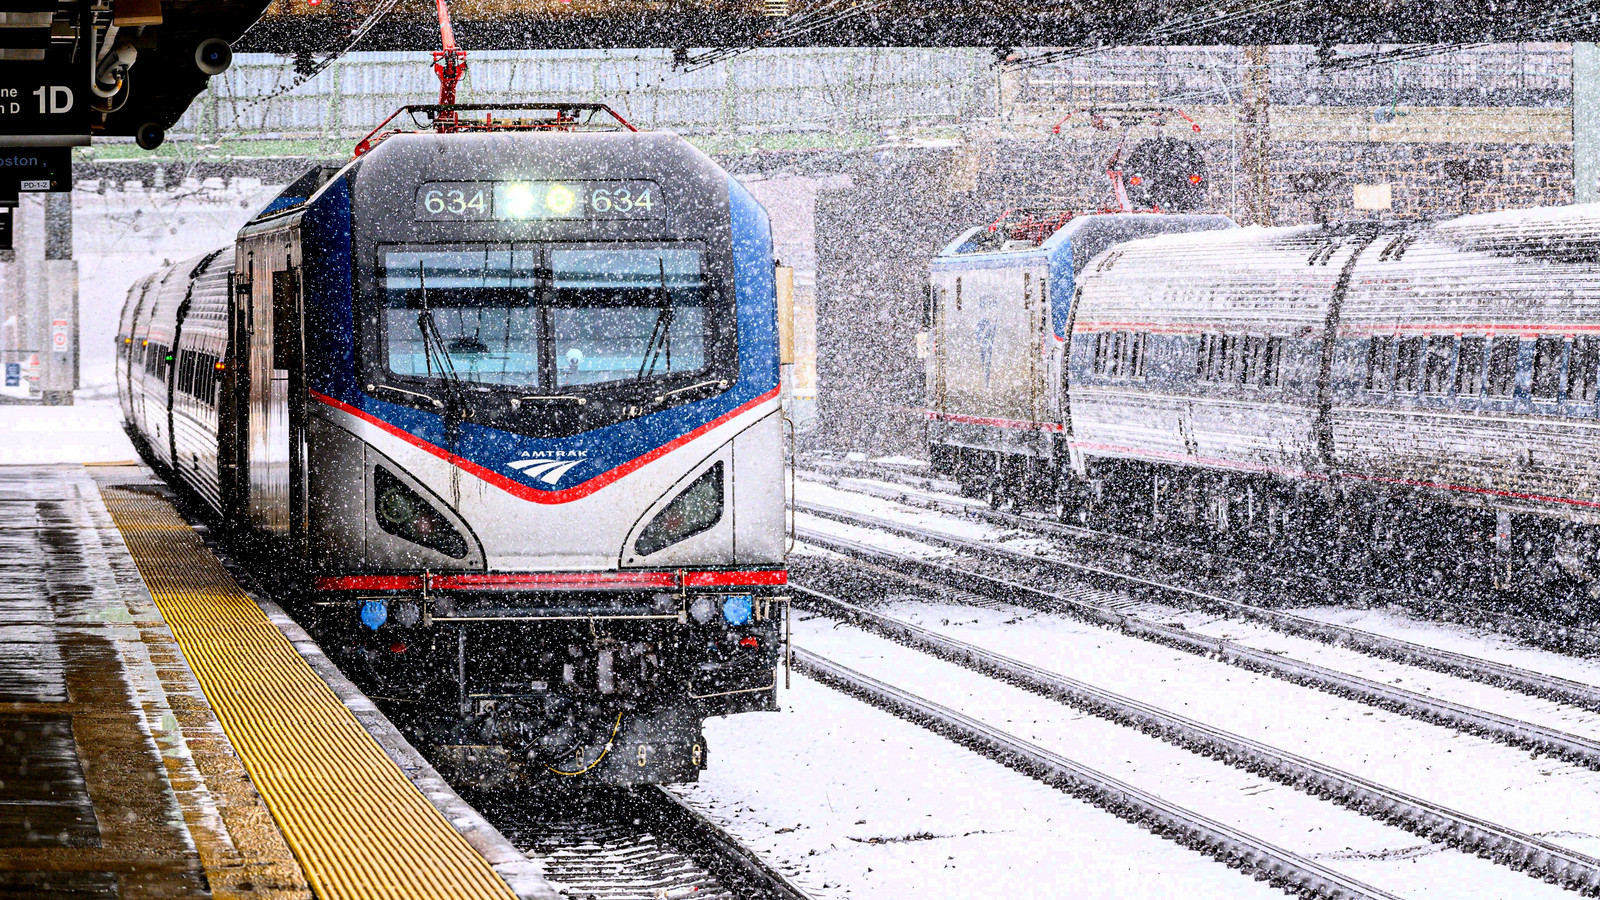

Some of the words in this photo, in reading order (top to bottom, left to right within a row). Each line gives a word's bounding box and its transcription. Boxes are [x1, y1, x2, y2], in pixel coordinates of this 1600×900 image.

[10, 103, 20, 113] D
[33, 86, 73, 113] 1D
[424, 189, 488, 214] 634
[591, 188, 654, 213] 634
[520, 450, 588, 458] AMTRAK
